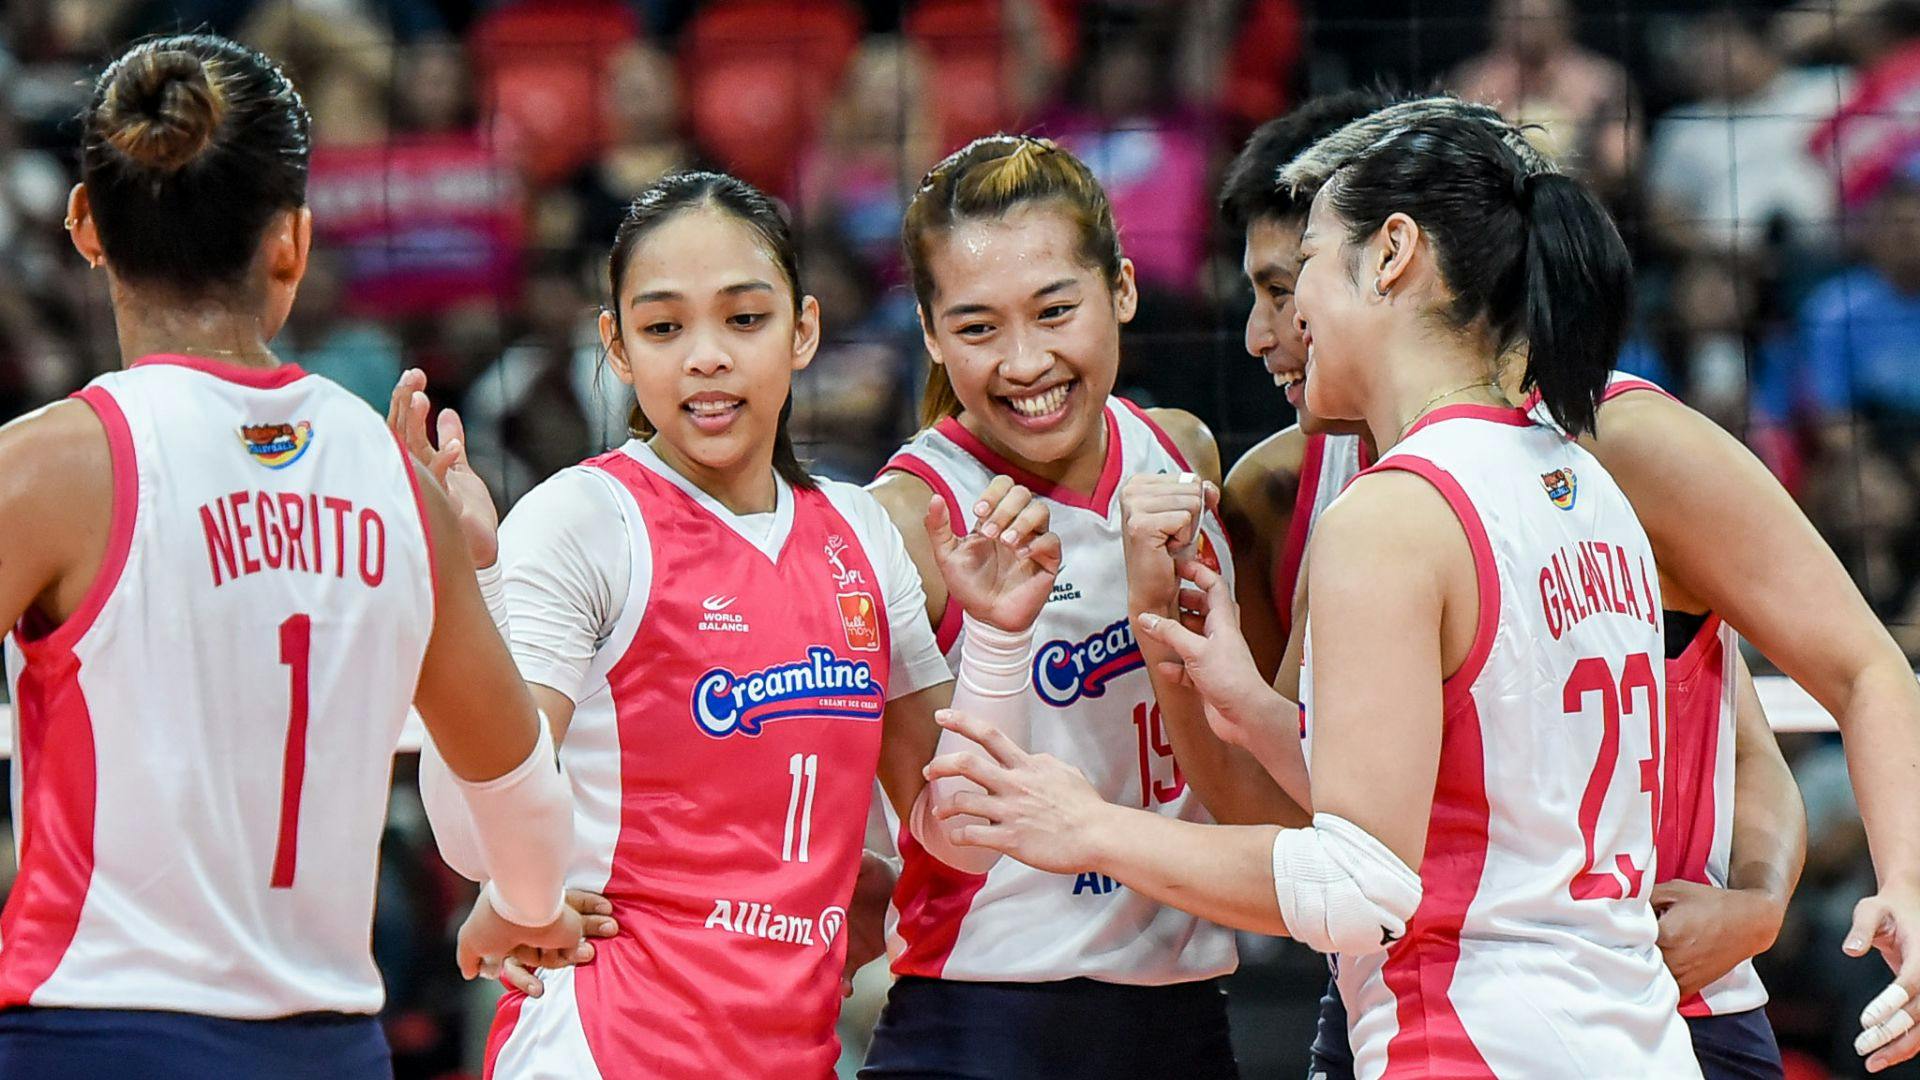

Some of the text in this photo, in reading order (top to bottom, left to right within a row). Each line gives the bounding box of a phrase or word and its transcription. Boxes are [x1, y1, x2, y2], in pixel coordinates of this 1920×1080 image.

[198, 490, 386, 588] NEGRITO
[698, 621, 750, 633] BALANCE
[703, 612, 743, 623] WORLD
[1053, 582, 1073, 593] RLD
[1539, 541, 1642, 641] GALANZA
[697, 651, 869, 732] Creamline
[847, 699, 860, 709] ICE
[269, 613, 311, 889] 1
[1562, 652, 1660, 901] 23
[782, 753, 818, 863] 11
[704, 899, 815, 946] Allianz
